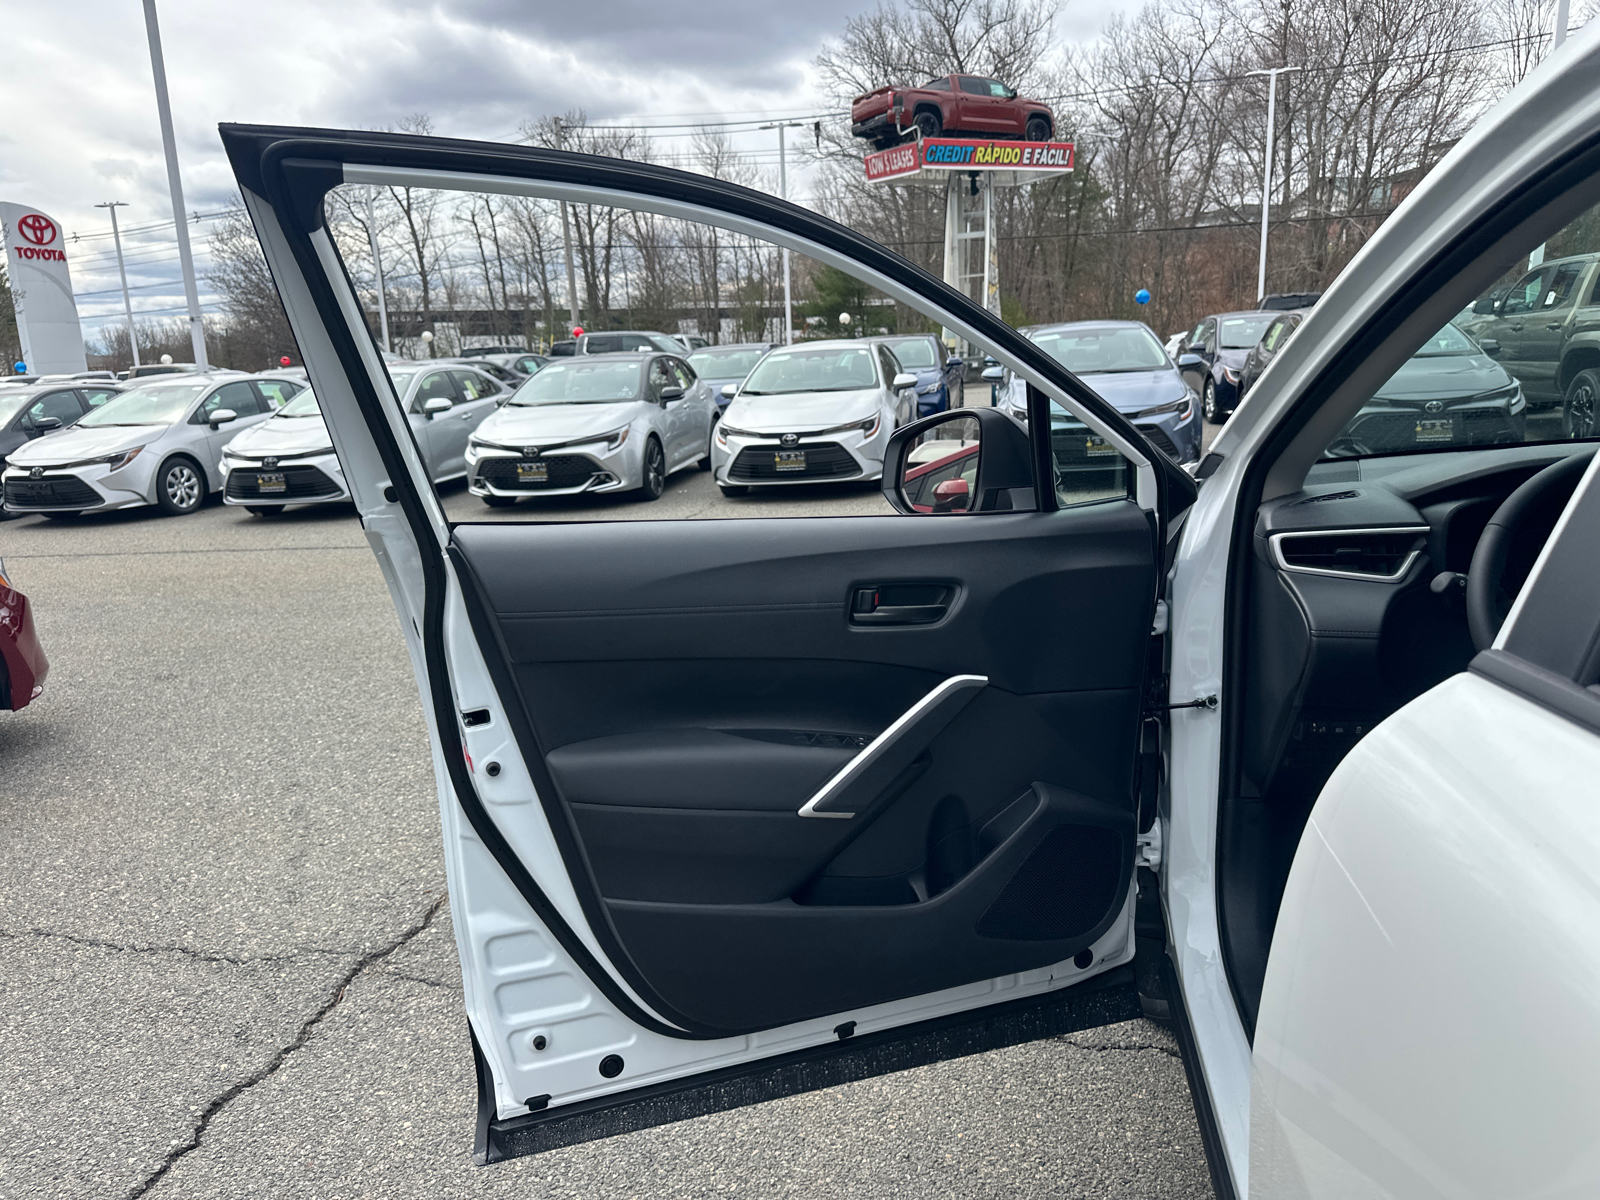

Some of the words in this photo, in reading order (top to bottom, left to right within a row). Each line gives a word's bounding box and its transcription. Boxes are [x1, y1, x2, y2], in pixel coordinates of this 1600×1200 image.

[869, 157, 884, 176] LOW
[889, 148, 914, 171] LEASES
[926, 145, 974, 163] CREDIT
[975, 143, 1021, 164] RÁPIDO
[1022, 147, 1032, 165] E
[1033, 144, 1070, 165] FÁCIL!
[14, 246, 66, 262] TOYOTA
